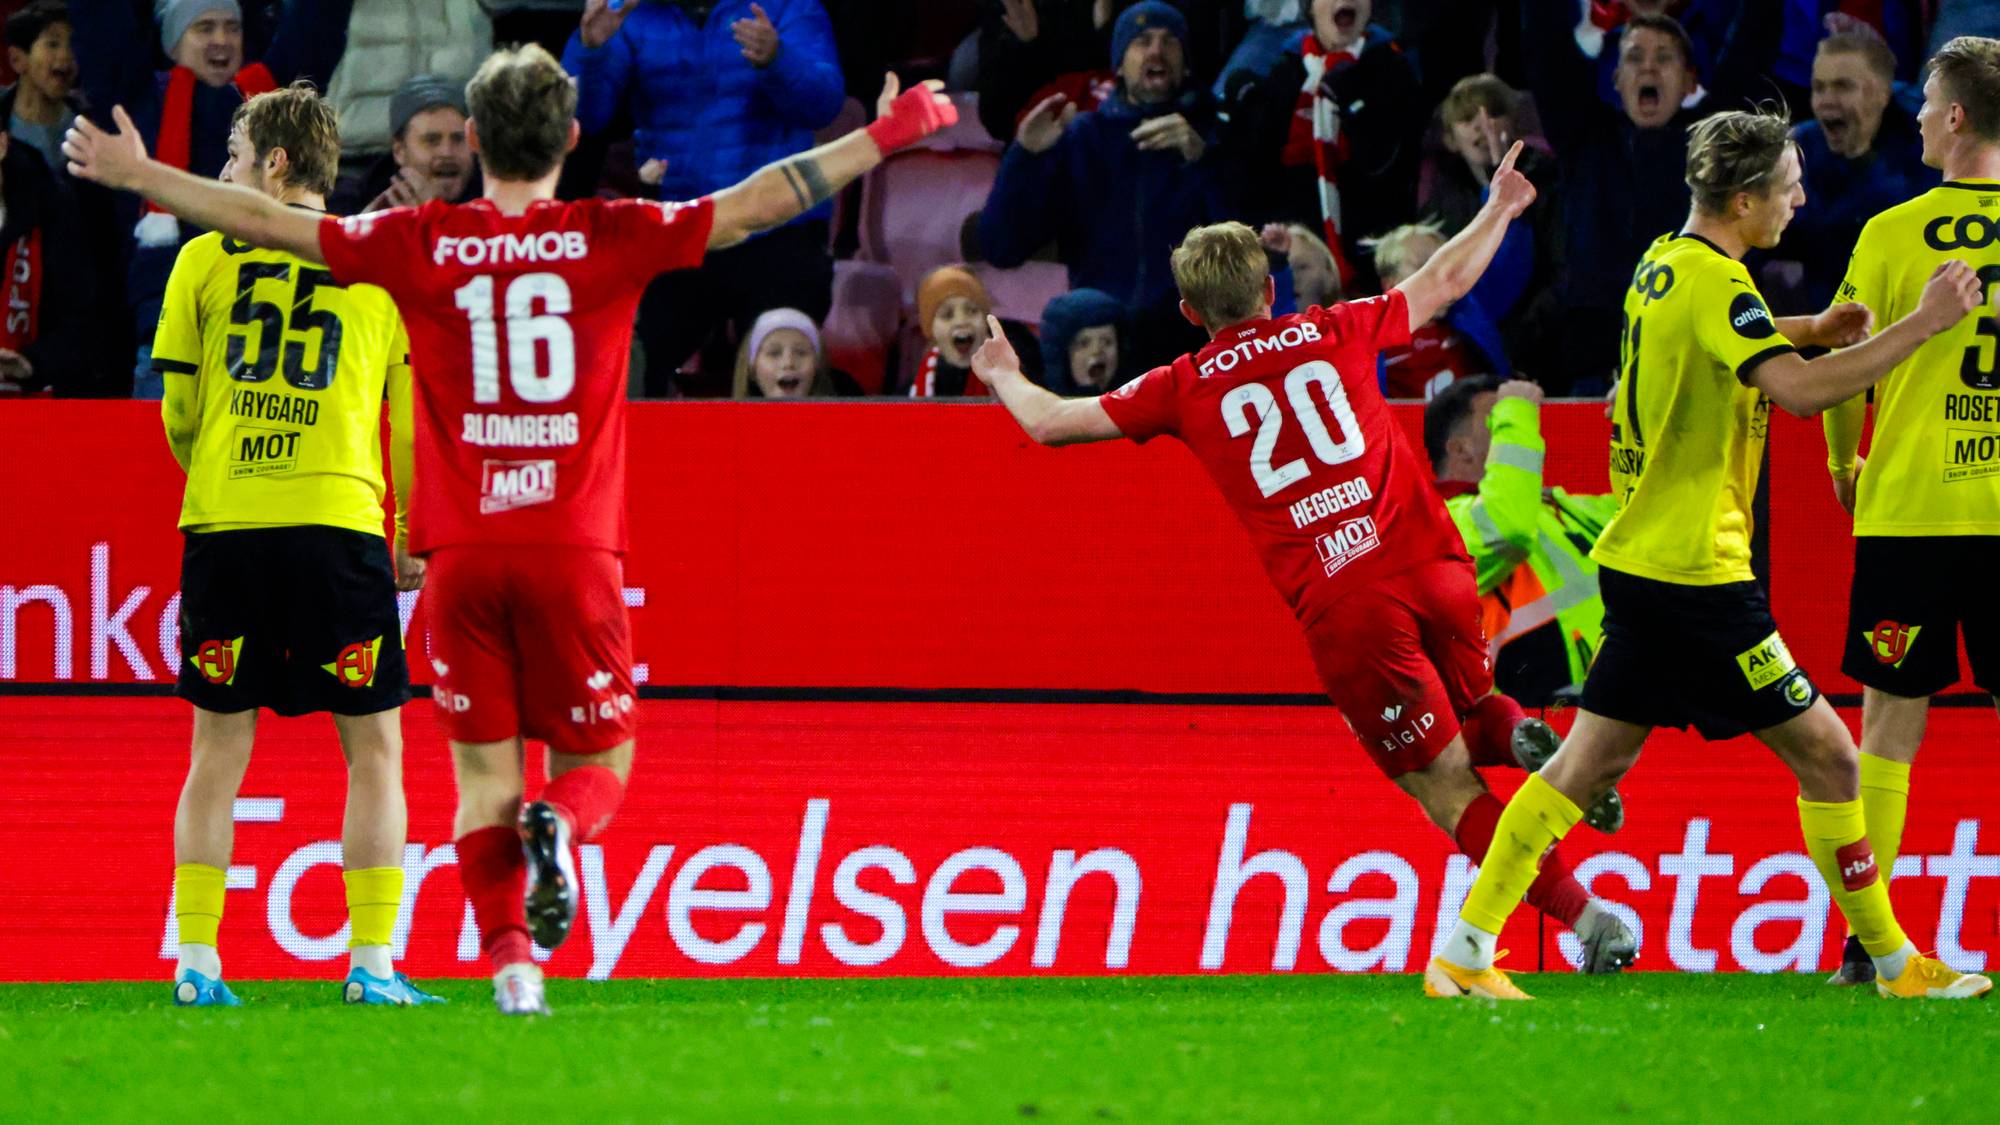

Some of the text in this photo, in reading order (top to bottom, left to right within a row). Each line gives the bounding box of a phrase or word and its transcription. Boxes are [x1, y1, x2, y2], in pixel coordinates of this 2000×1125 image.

[433, 231, 588, 265] FOTMOB
[1923, 214, 2000, 251] co
[225, 261, 347, 391] 55
[454, 272, 576, 404] 16
[1199, 322, 1322, 378] FOTMOB
[240, 432, 301, 462] MOT
[461, 412, 579, 447] BLOMBERG
[1221, 360, 1366, 499] 20
[492, 461, 555, 496] MOT
[1289, 476, 1373, 529] HEGGEBØ
[1323, 518, 1373, 558] MOT
[159, 797, 1142, 980] Foryelsen
[1557, 817, 2000, 974] stat
